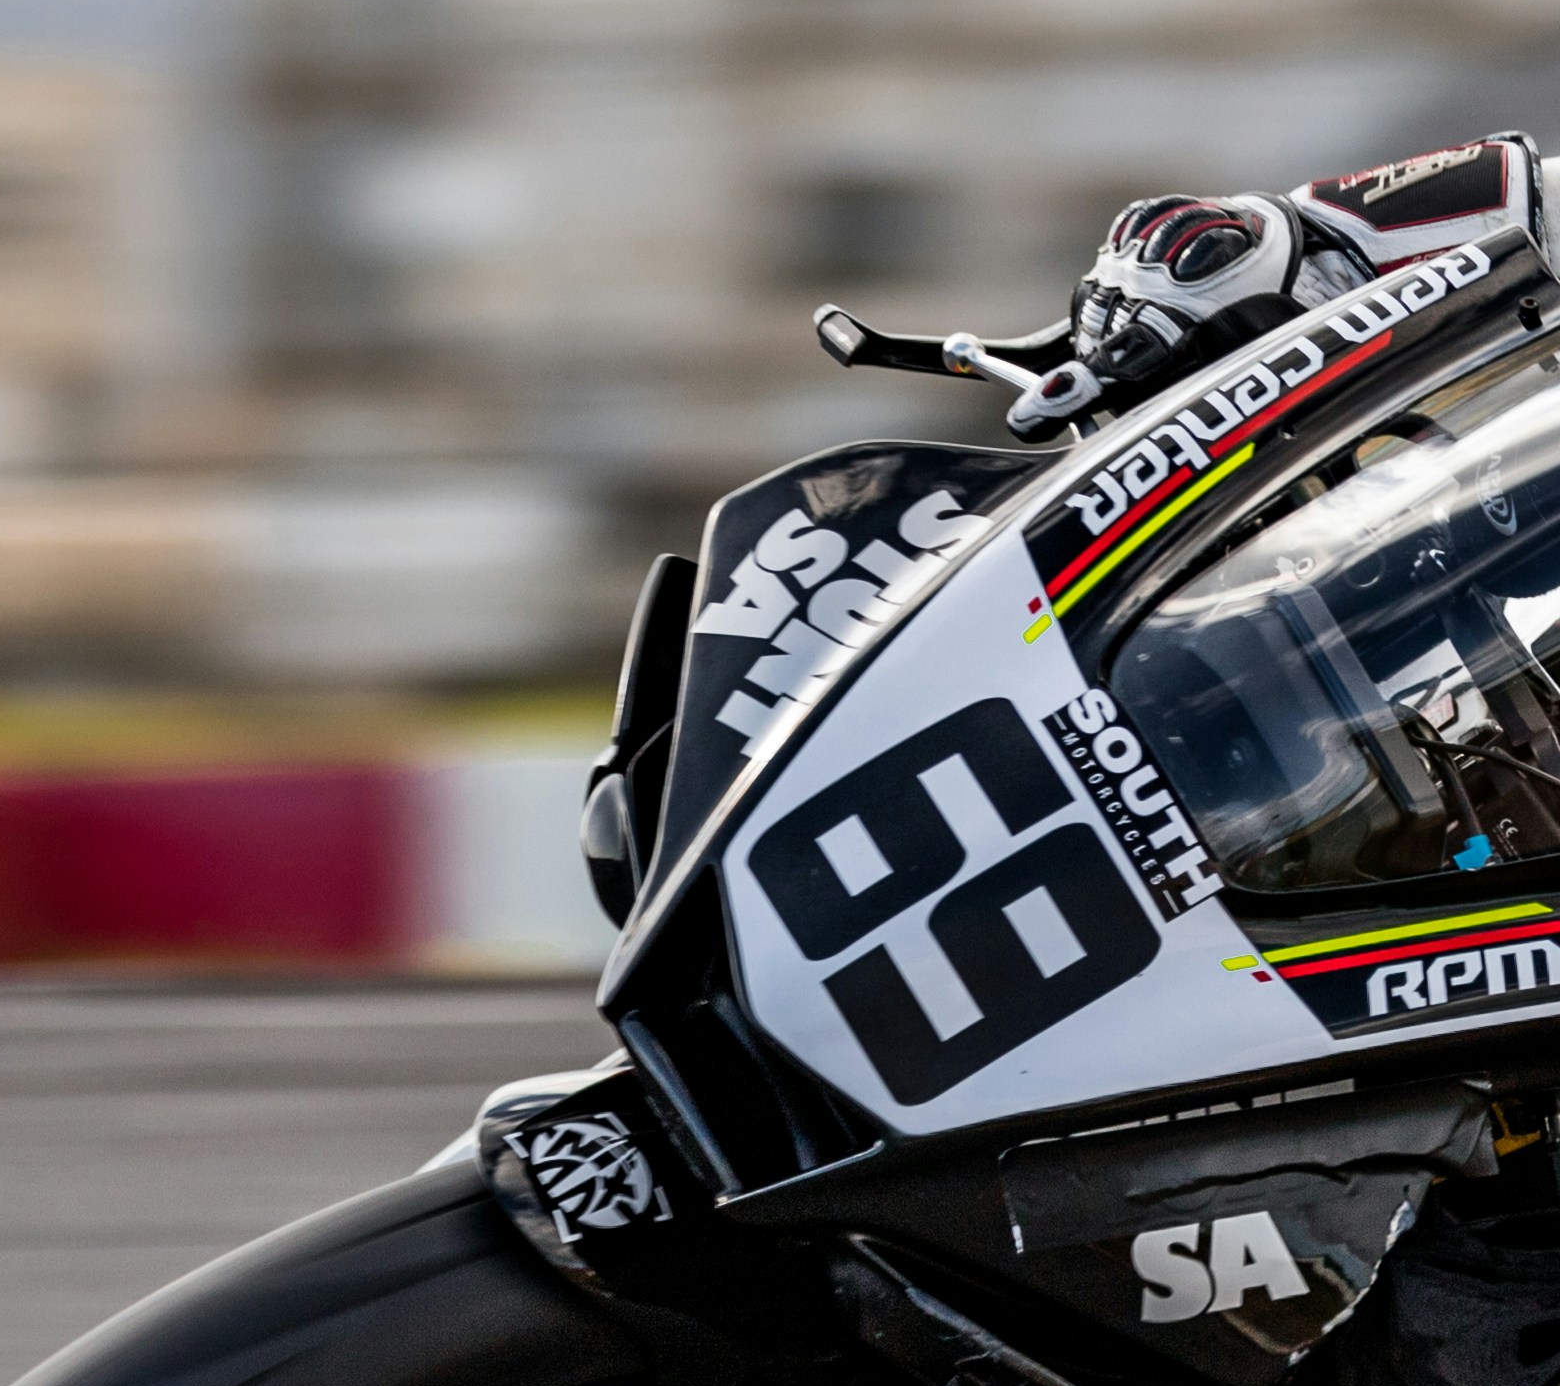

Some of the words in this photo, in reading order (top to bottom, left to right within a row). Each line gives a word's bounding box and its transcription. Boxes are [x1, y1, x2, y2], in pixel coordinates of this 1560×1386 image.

[690, 507, 850, 640] SA
[1062, 729, 1166, 886] MOTORCYCLES
[1066, 688, 1225, 911] SOUTH
[746, 696, 1162, 1107] 69
[1130, 1211, 1310, 1325] SA
